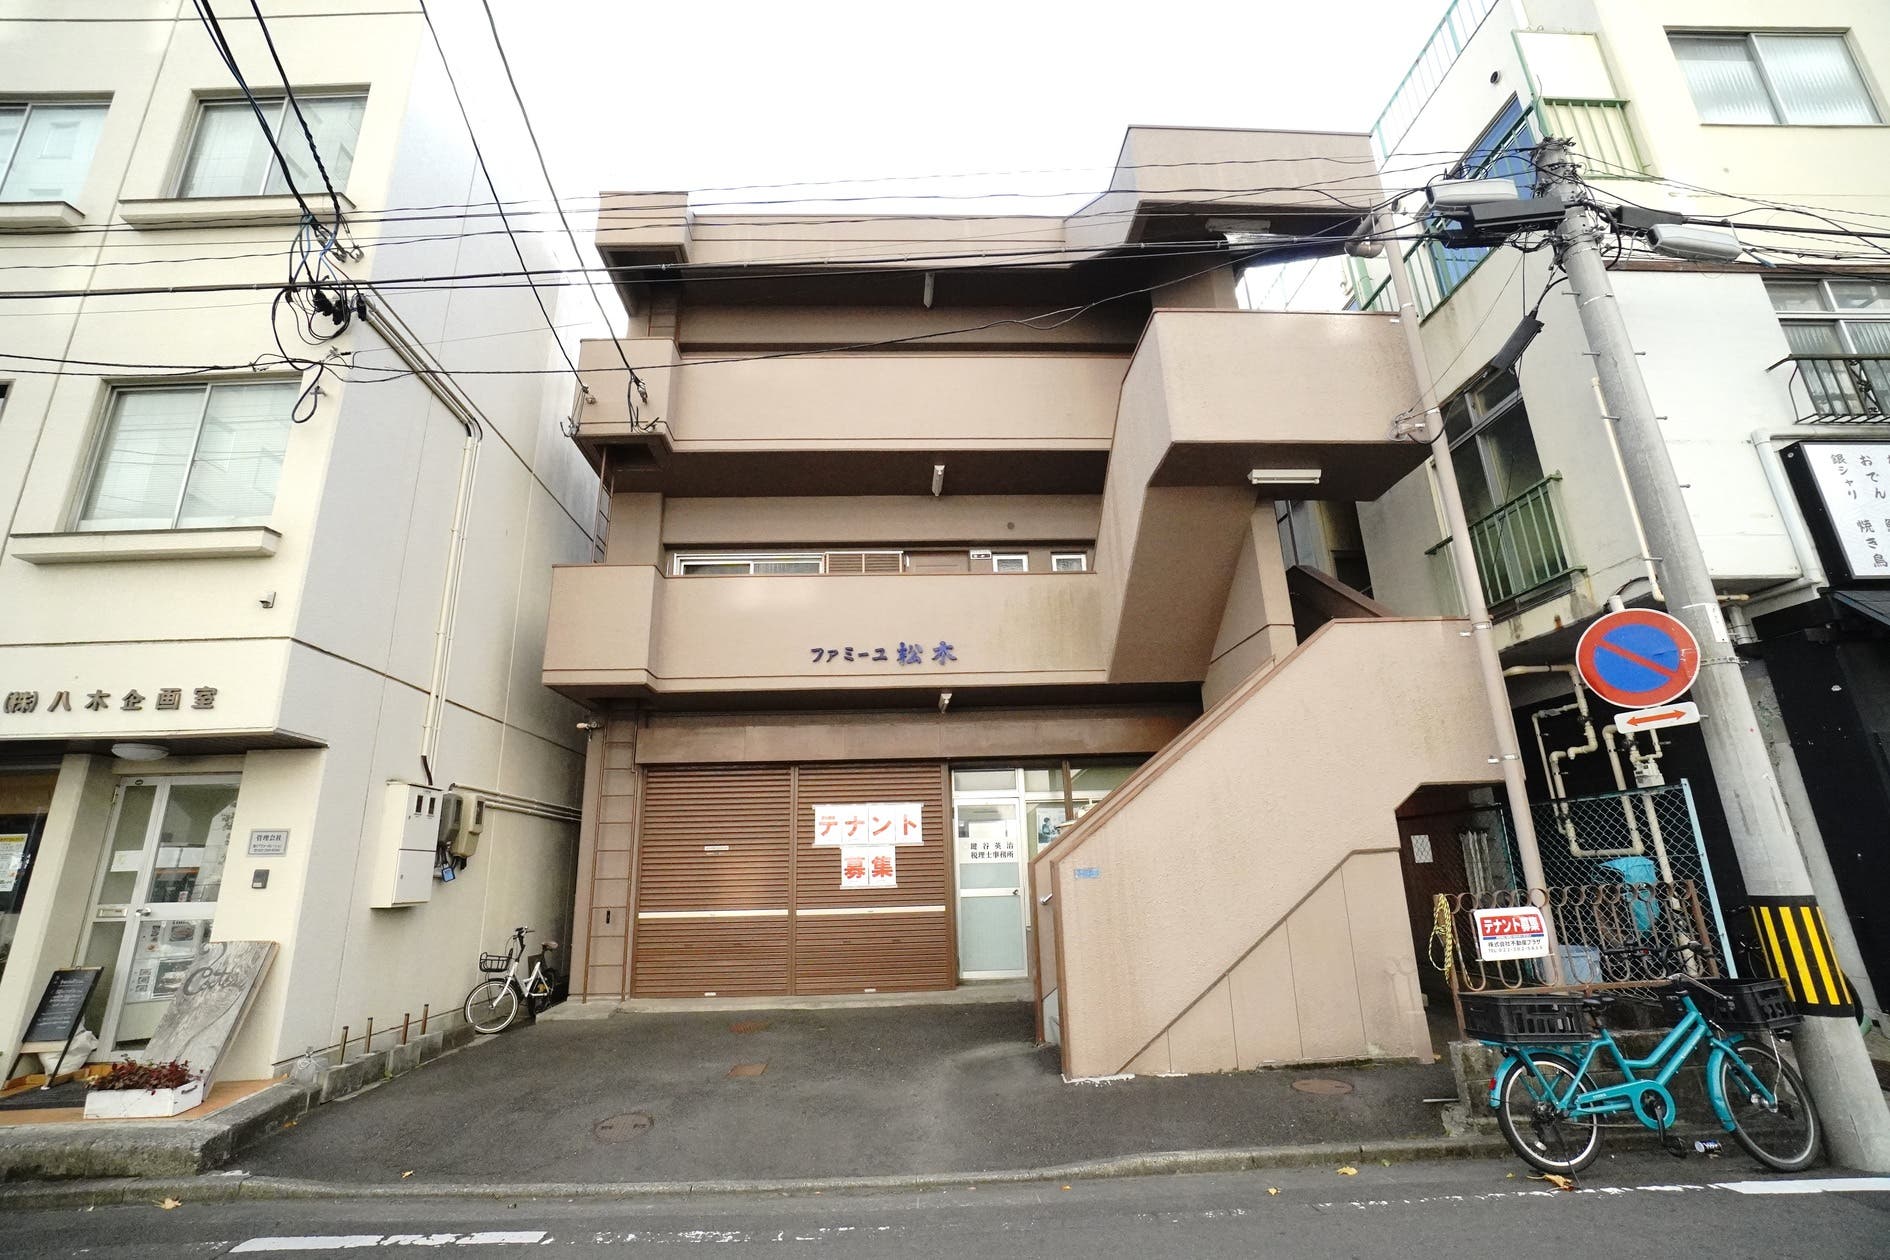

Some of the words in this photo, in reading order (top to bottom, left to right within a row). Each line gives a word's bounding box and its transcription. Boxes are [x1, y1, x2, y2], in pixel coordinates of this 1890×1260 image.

[1830, 453, 1857, 500] 銀シャリ
[1859, 455, 1887, 500] おでん
[1856, 519, 1889, 568] 焼き鳥
[818, 814, 917, 837] テナント
[971, 850, 1014, 859] 税理士事務所
[844, 856, 894, 879] 募集
[1483, 916, 1541, 934] テナント募集
